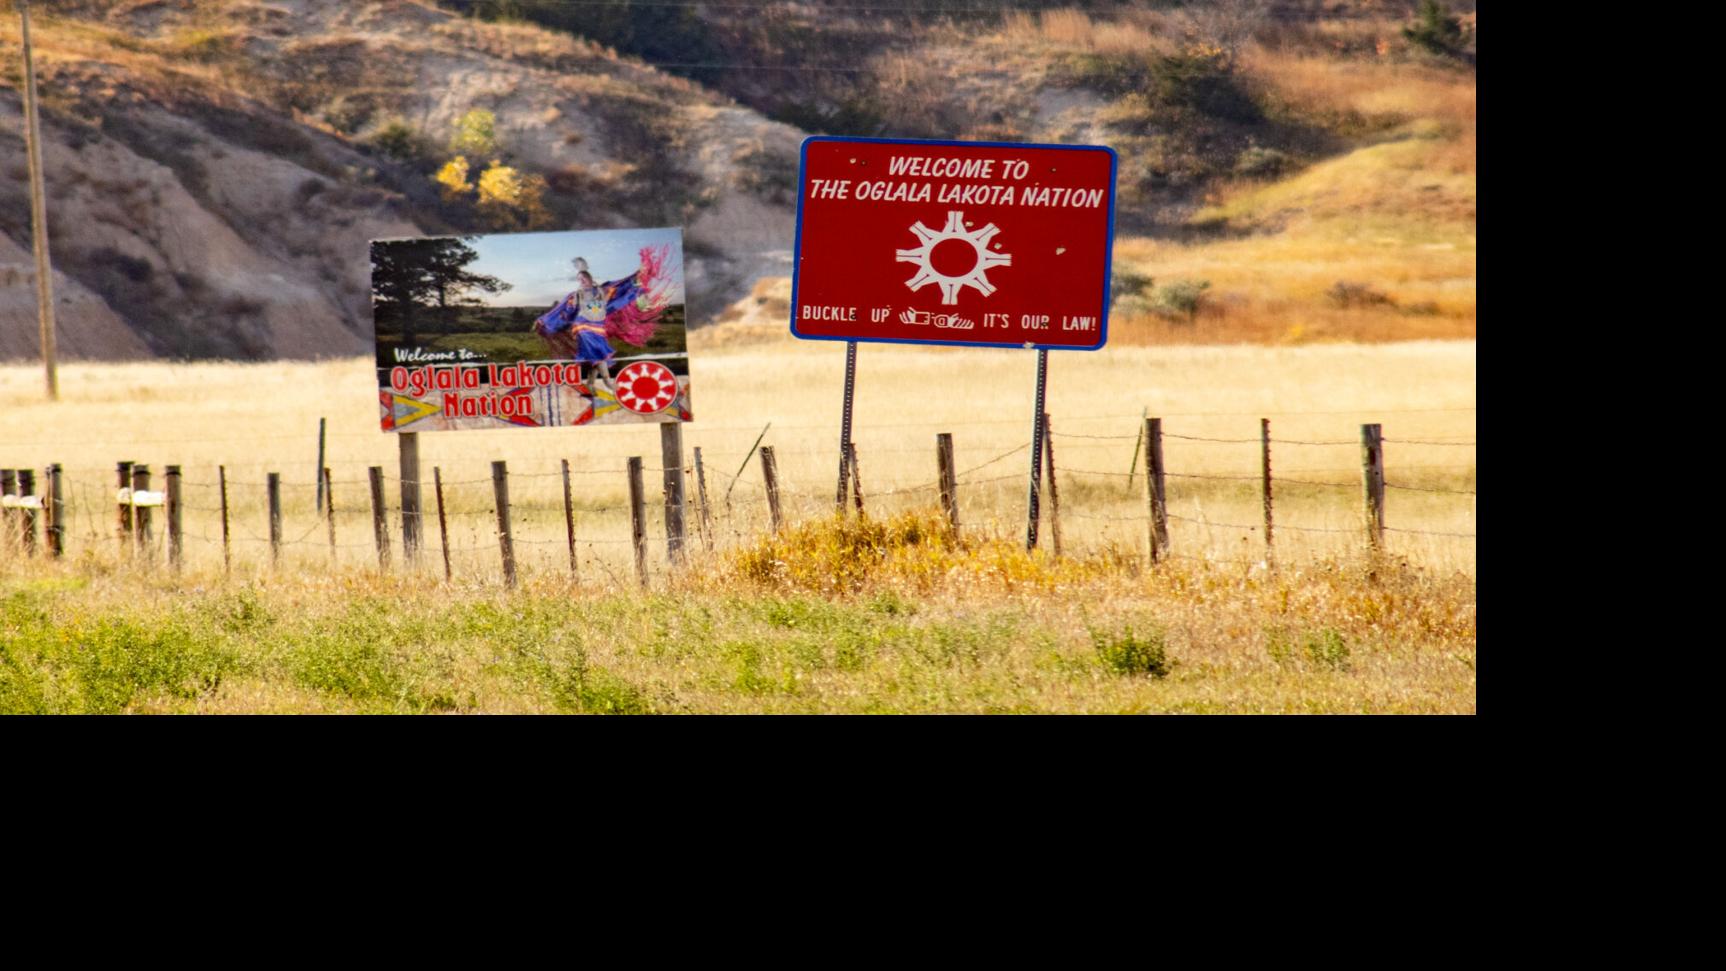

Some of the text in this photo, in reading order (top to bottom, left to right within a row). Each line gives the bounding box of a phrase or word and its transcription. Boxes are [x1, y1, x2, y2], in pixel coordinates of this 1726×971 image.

[889, 157, 1029, 180] WELCOME TO
[810, 179, 1104, 208] THE OGLALA LAKOTA NATION
[802, 305, 1096, 331] BUCKLE UP IT'S OUR LAW!
[394, 347, 456, 363] Welcome
[391, 361, 582, 398] Oglala Lakota
[443, 392, 533, 418] Nation
